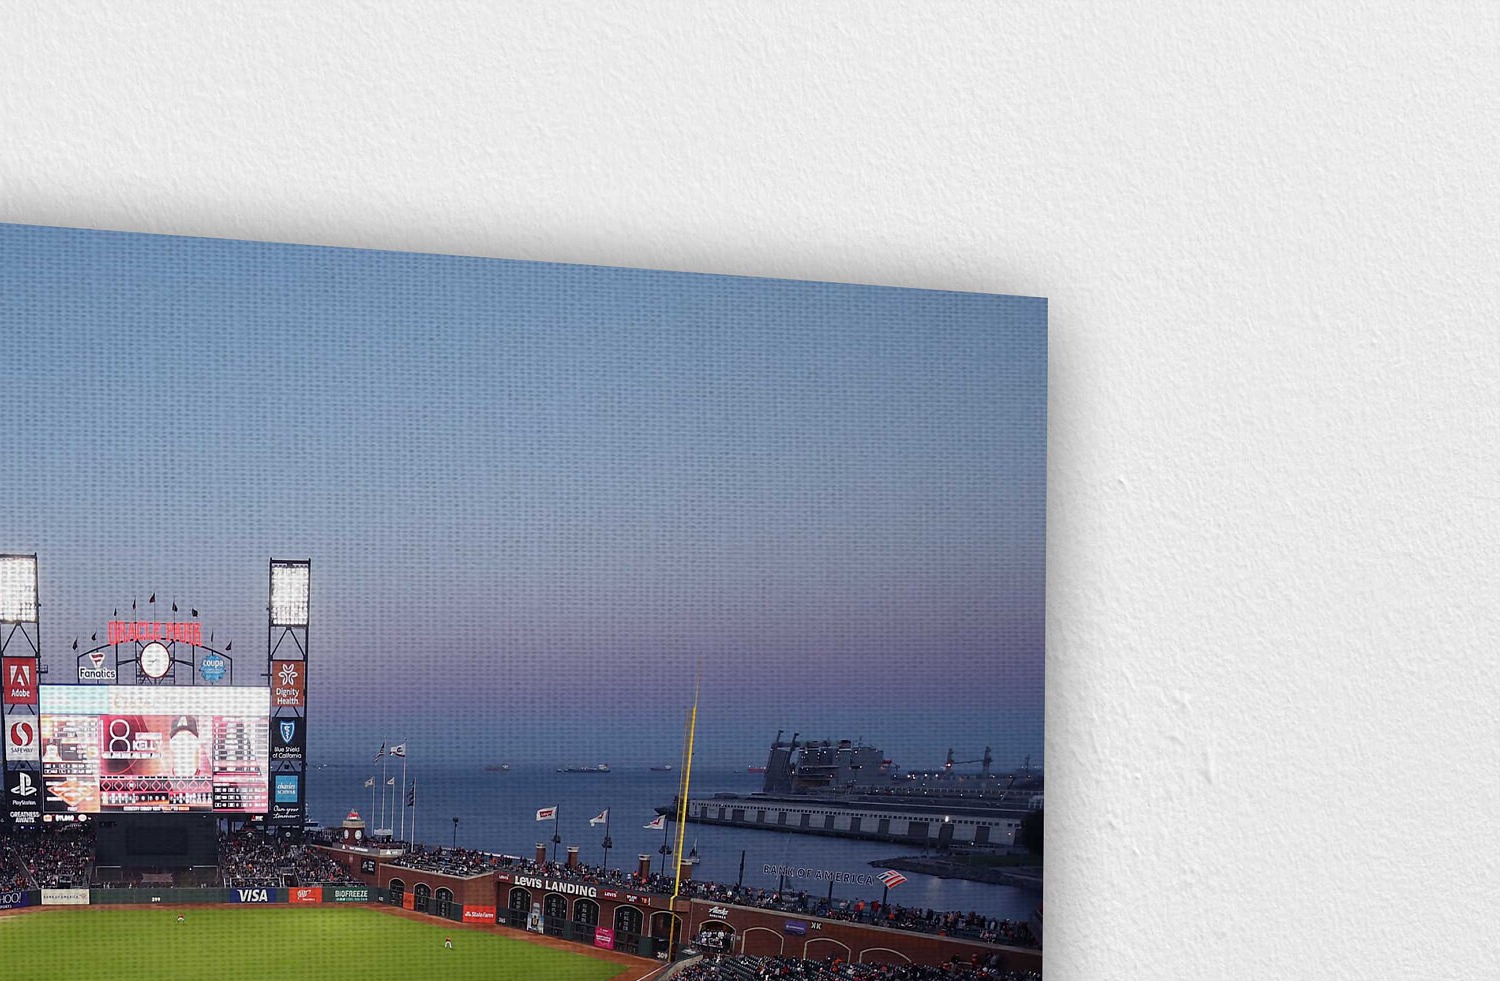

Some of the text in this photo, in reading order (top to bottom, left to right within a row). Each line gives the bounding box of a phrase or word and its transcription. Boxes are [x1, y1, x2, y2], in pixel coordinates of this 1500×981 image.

[107, 620, 203, 647] ORACLE PARK
[203, 659, 224, 669] coupa
[79, 667, 116, 680] Fanatics
[10, 688, 31, 698] Adobe
[275, 687, 300, 697] Dignity
[277, 697, 299, 705] Health
[133, 739, 163, 751] KELLY
[12, 799, 37, 807] PlayStation
[762, 863, 874, 887] BANK OF AMERICA
[334, 889, 368, 898] BIOFREEZE
[544, 879, 597, 898] LANDING
[237, 889, 268, 902] VISA
[708, 906, 729, 915] Alaska
